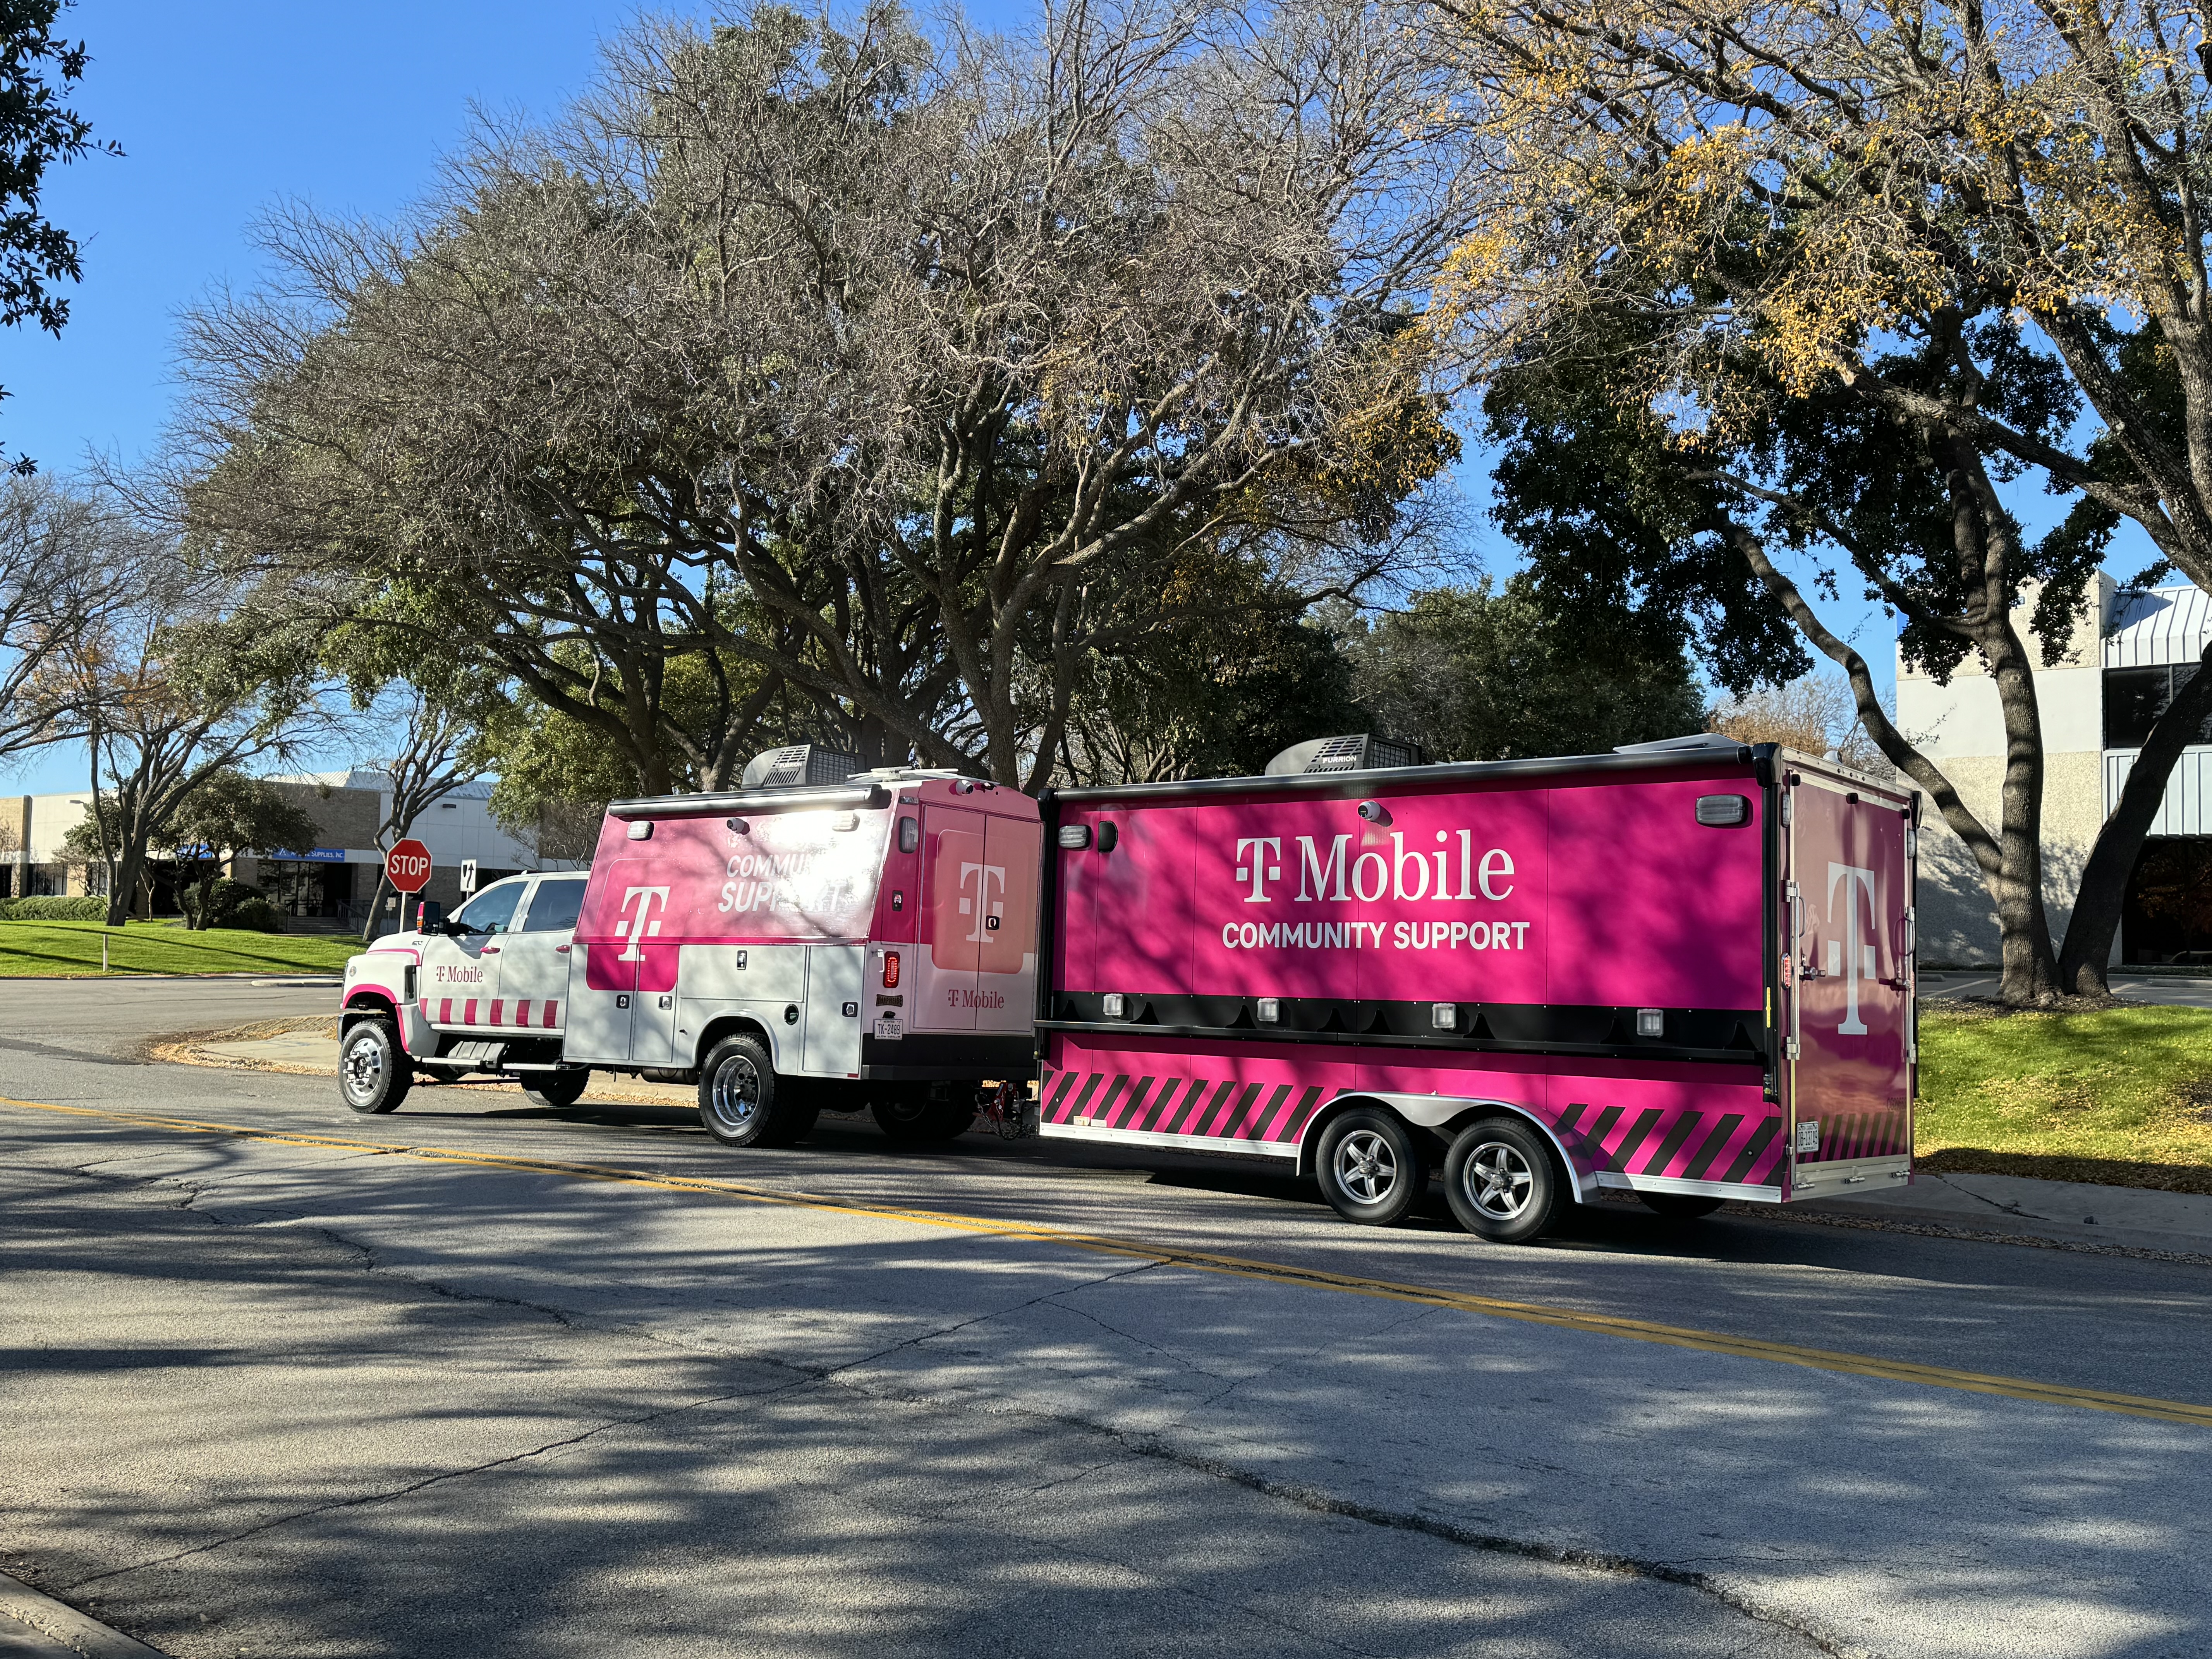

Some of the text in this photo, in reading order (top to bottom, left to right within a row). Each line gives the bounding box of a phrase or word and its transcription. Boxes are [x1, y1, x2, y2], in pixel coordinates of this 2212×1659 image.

[1322, 755, 1357, 764] FURRION
[390, 854, 429, 876] STOP
[1294, 829, 1515, 902] Mobile
[1222, 921, 1530, 950] COMMUNITY SUPPORT
[1827, 861, 1876, 1035] T
[447, 966, 483, 982] Mobile
[962, 990, 1004, 1008] Mobile
